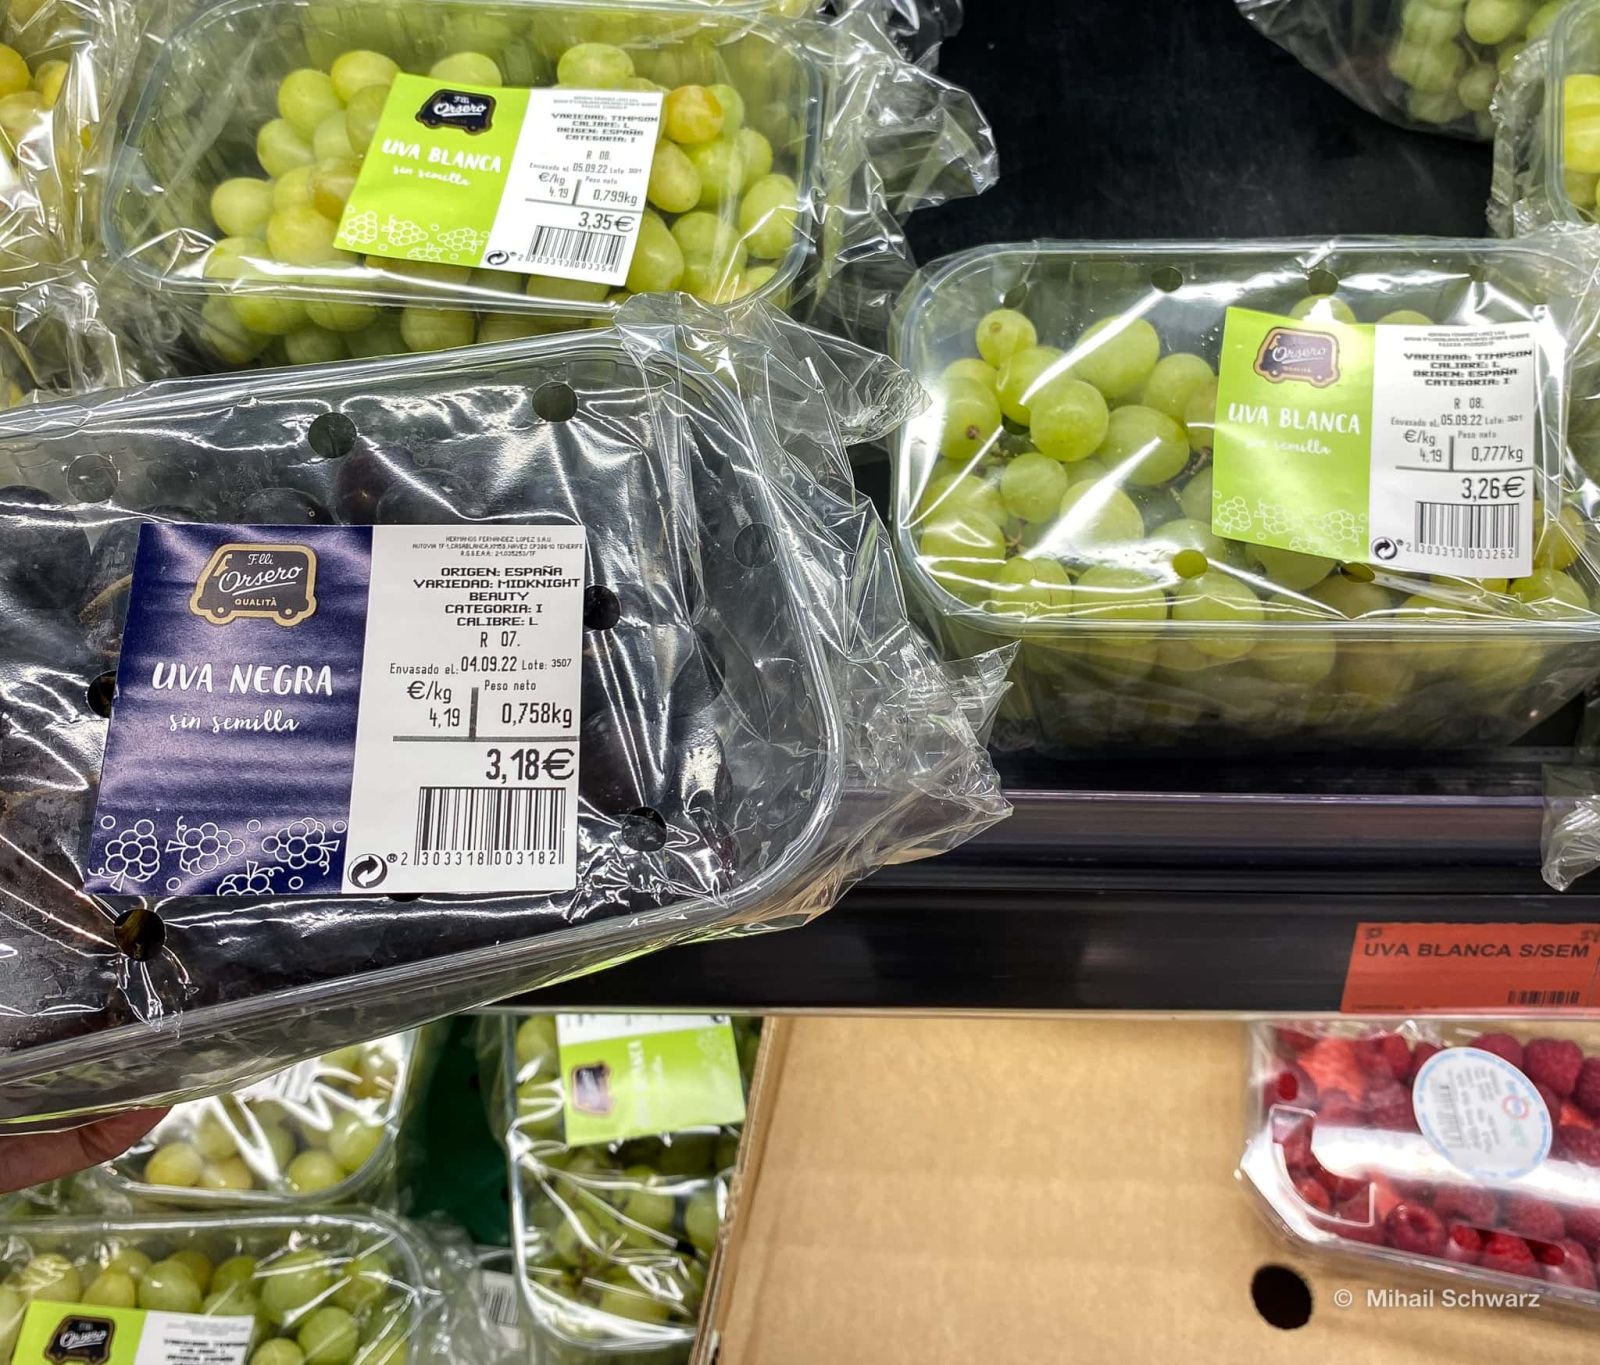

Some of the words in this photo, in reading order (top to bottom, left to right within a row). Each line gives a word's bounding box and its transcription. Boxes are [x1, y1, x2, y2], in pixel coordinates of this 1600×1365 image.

[433, 102, 487, 117] Orsero
[602, 128, 644, 136] ESPAÑA
[381, 138, 421, 160] UVA
[428, 145, 502, 173] BLANCA
[538, 172, 566, 186] €/kg
[578, 211, 636, 232] 3,35€
[1272, 346, 1329, 363] Orsero
[1403, 352, 1472, 360] VARIEDAD:
[1475, 350, 1533, 360] TIMPSON
[1412, 370, 1464, 378] ORIGEN:
[1468, 368, 1518, 378] ESPAÑA
[1454, 398, 1460, 409] R
[1228, 402, 1269, 427] UVA
[1280, 407, 1361, 435] BLANCA
[1440, 414, 1482, 426] 05.09.22
[1403, 429, 1436, 447] €/kg
[1458, 430, 1476, 439] Peso
[1471, 445, 1524, 463] 0,777kg
[1461, 476, 1526, 502] 3,26€
[218, 565, 304, 593] Orsero
[440, 568, 500, 577] ORIGEN:
[504, 566, 562, 576] ESPAÑA
[413, 579, 494, 589] VARIEDAD:
[498, 578, 581, 588] MIDKNIGHT
[234, 596, 278, 606] QUALITÀ
[469, 592, 530, 602] BEAUTY
[444, 604, 532, 614] CATEGORIA:
[536, 604, 543, 613] I
[456, 616, 525, 626] CALIBRE:
[529, 617, 538, 626] L
[480, 631, 488, 648] R
[500, 630, 520, 648] 07.
[390, 662, 440, 674] Envasado
[460, 656, 518, 672] 04.09.22
[522, 660, 548, 670] Lote:
[551, 658, 572, 668] 3507
[152, 662, 213, 693] UVA
[229, 664, 333, 697] NEGRA
[484, 680, 508, 691] Peso
[514, 680, 537, 691] neto
[406, 680, 452, 704] €/kg
[170, 714, 201, 732] sin
[212, 708, 300, 734] semilla
[429, 708, 460, 728] 4,19
[501, 702, 573, 729] 0,758kg
[486, 748, 576, 784] 3,18€
[400, 852, 408, 866] 2
[422, 852, 484, 866] 303318
[494, 851, 556, 866] 003182
[1364, 943, 1411, 957] UVA
[1417, 943, 1512, 958] BLANCA
[1518, 944, 1591, 958] S/SEM
